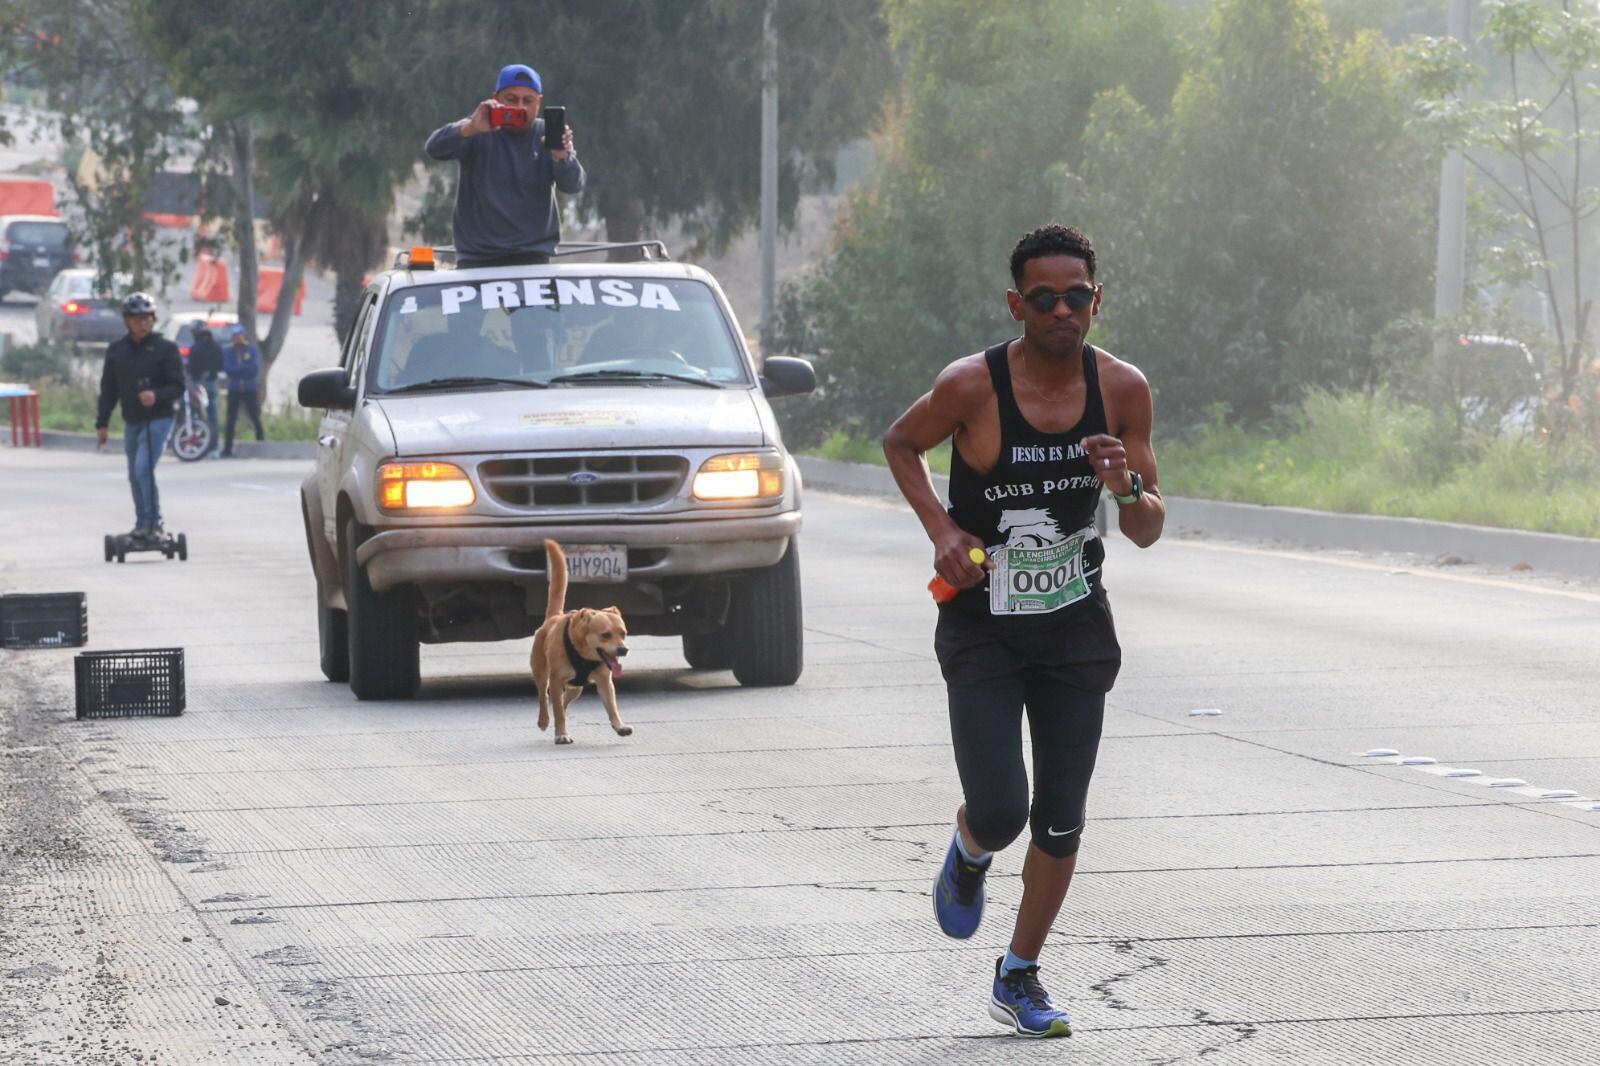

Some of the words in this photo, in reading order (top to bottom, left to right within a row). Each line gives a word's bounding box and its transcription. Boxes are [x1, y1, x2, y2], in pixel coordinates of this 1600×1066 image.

[441, 278, 681, 315] PRENSA
[1011, 444, 1045, 464] JESÚS
[1049, 446, 1063, 462] ES
[984, 483, 1034, 502] CLUB
[1013, 551, 1025, 560] LA
[1013, 557, 1077, 593] 0001
